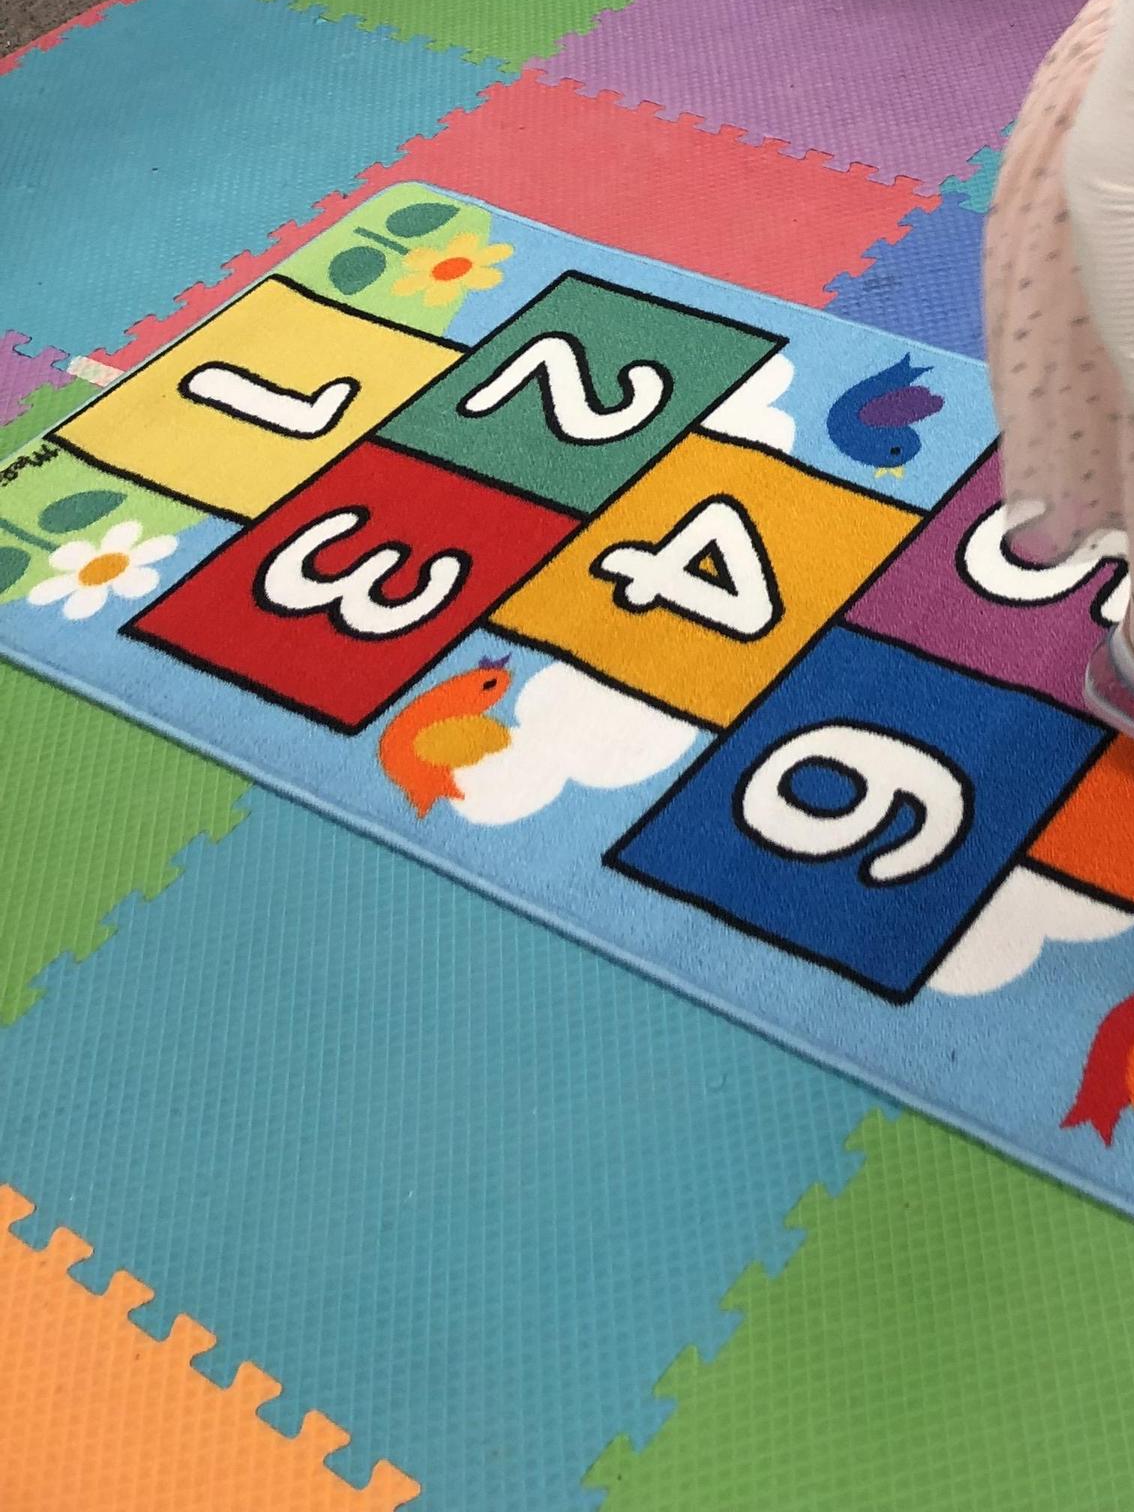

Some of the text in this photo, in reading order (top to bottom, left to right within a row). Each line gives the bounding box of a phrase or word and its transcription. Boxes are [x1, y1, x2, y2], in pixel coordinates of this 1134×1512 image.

[178, 361, 361, 439] 1
[456, 331, 674, 446] 2
[252, 504, 474, 641] 3
[589, 493, 785, 643] 4
[731, 717, 975, 888] 6
